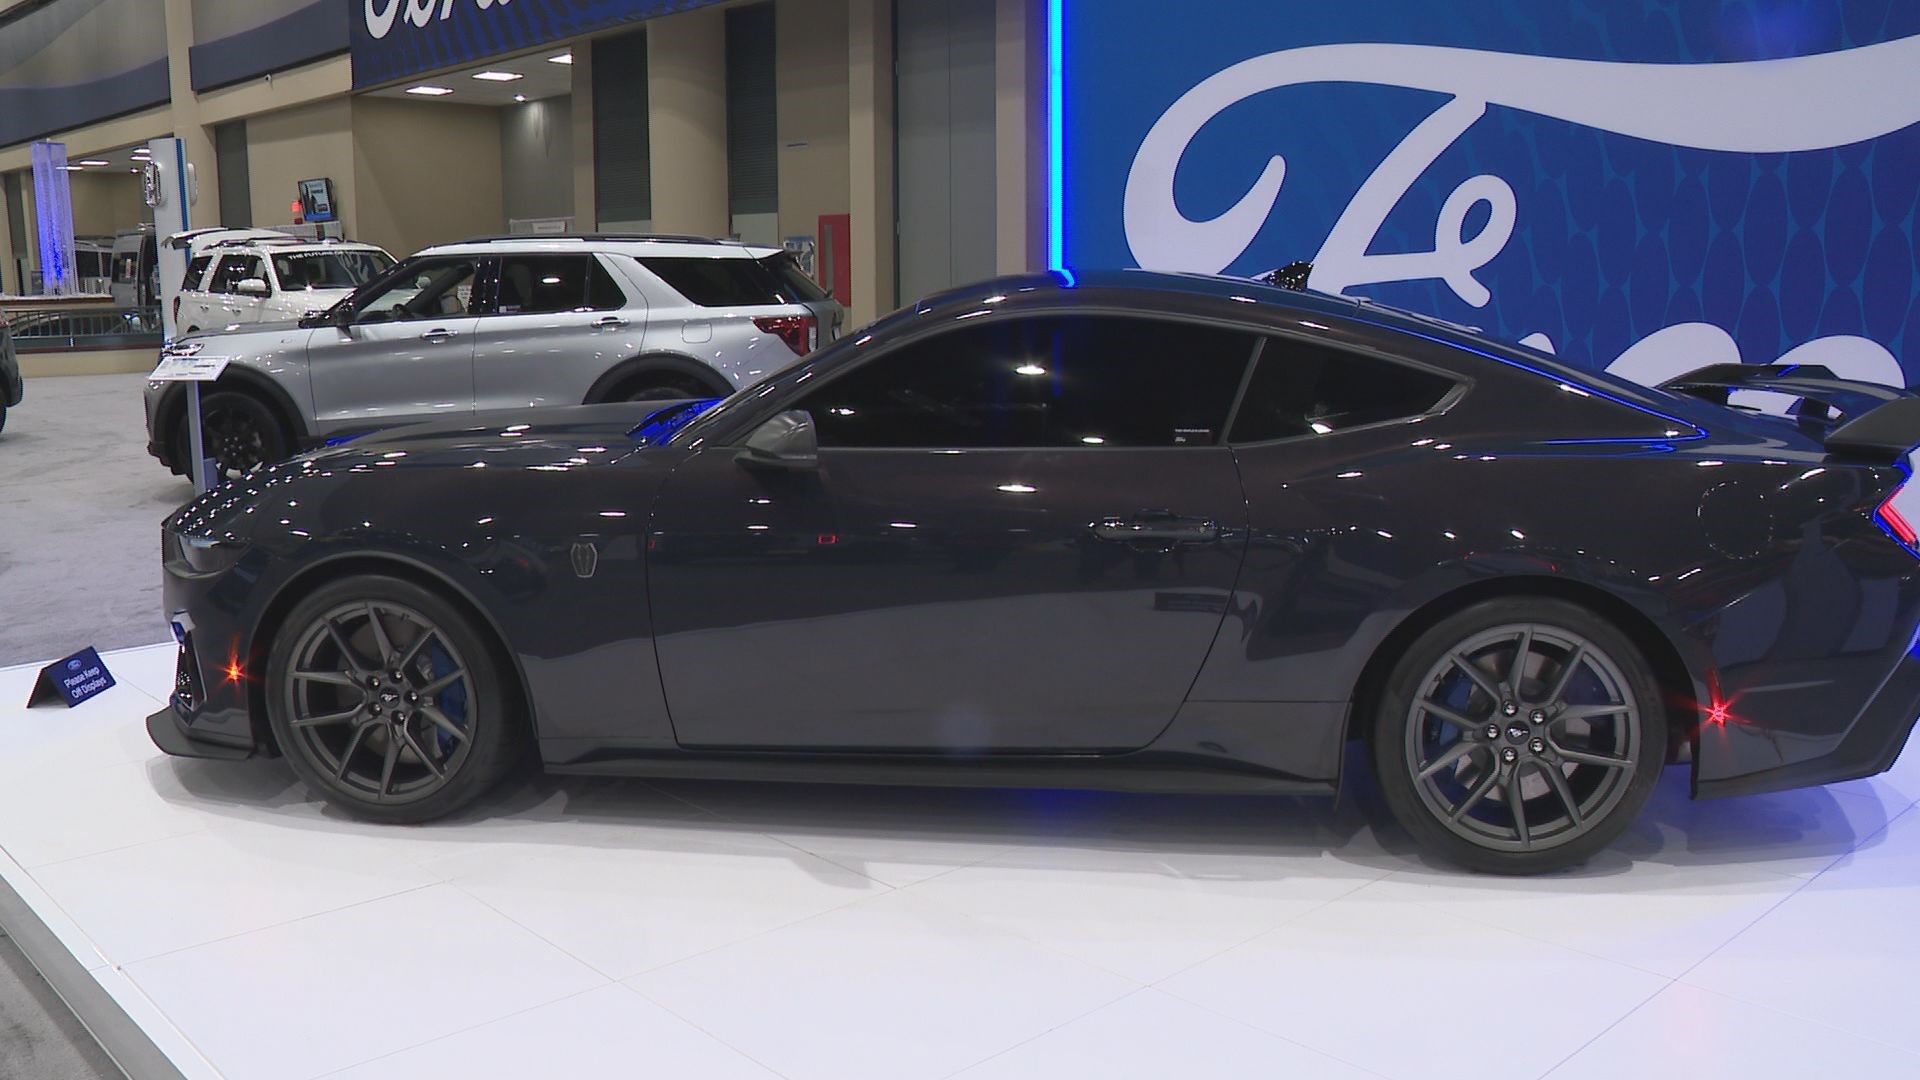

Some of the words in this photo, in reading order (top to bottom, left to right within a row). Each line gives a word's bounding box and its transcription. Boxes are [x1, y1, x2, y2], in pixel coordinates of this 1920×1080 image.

[64, 673, 86, 688] Please
[83, 666, 100, 679] Keep
[71, 686, 83, 698] Off
[81, 676, 107, 693] Displays
